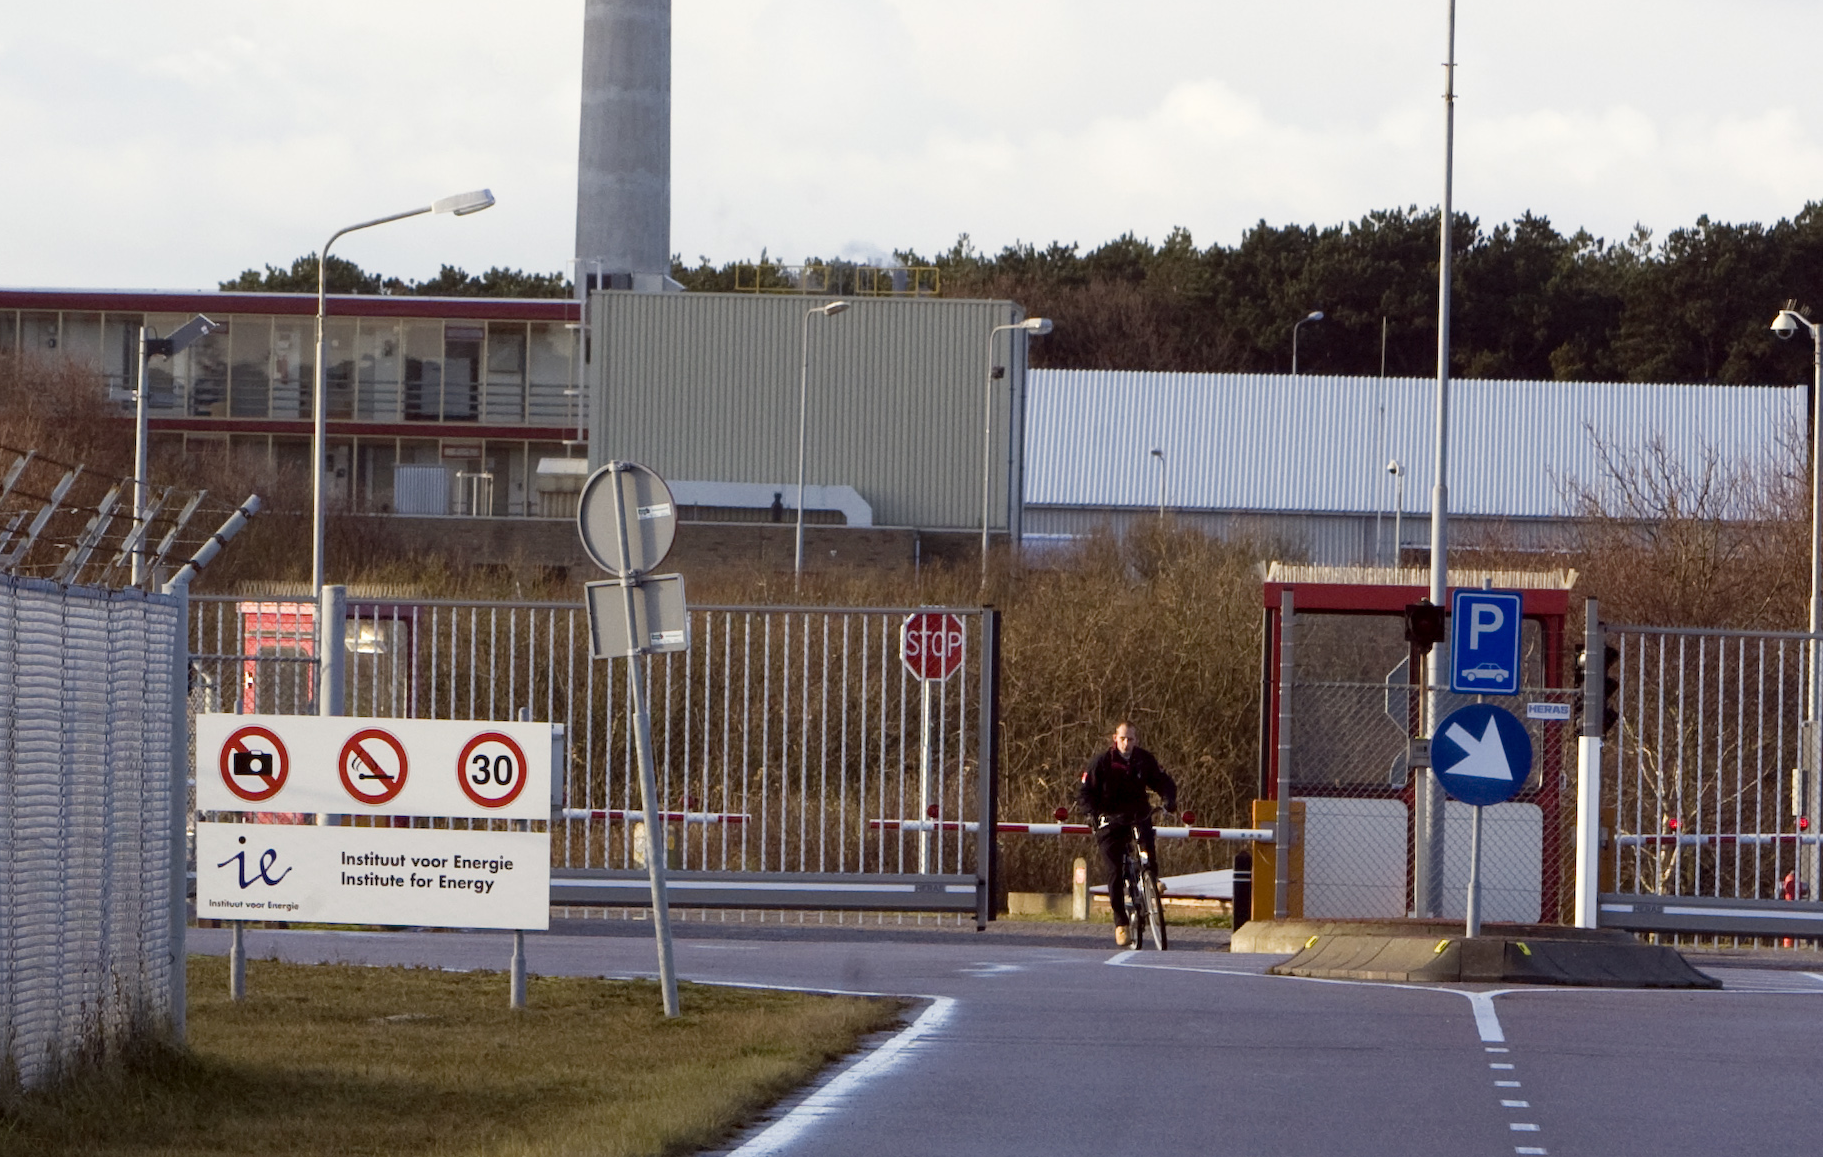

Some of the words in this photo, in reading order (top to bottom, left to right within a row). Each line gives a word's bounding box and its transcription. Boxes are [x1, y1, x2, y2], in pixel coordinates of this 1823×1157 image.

[1469, 602, 1505, 651] P
[906, 630, 963, 657] STOP
[1528, 704, 1569, 714] HERAS
[471, 754, 513, 786] 30
[341, 851, 406, 867] Instituut
[411, 857, 448, 869] voor
[453, 855, 514, 874] Energie
[341, 871, 405, 887] Institute
[410, 872, 434, 888] for
[439, 874, 495, 894] Energy
[209, 899, 243, 908] Instituut
[267, 901, 299, 912] Energie
